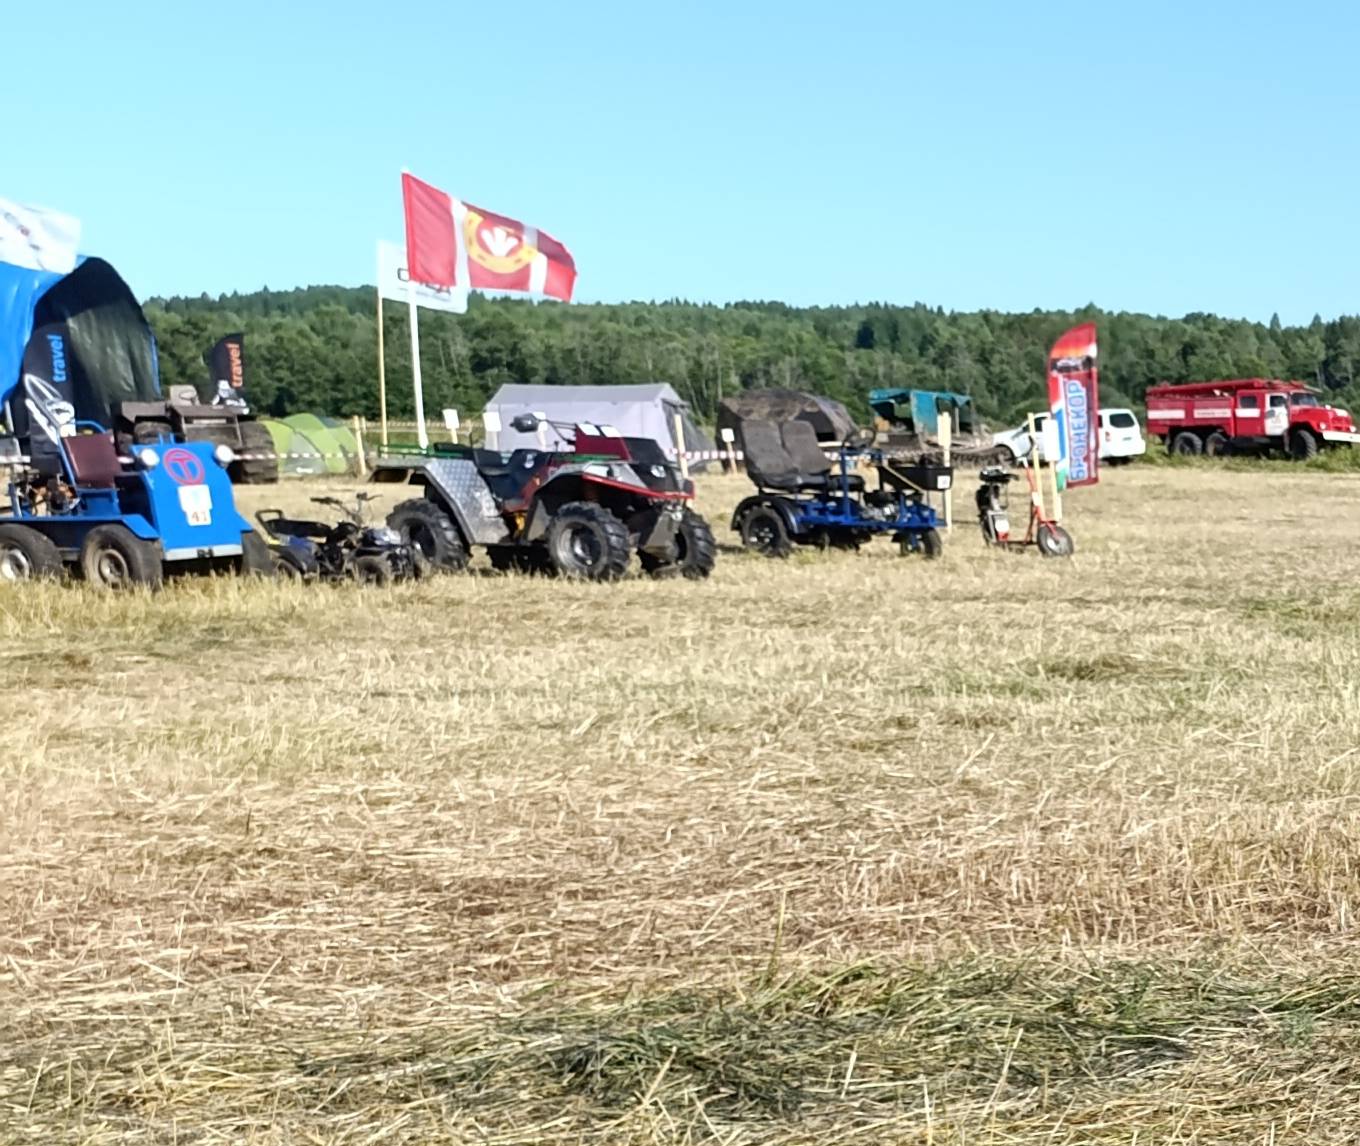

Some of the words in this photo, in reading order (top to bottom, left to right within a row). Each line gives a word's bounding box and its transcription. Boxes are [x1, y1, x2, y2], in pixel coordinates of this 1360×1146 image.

[47, 334, 67, 383] travel
[226, 342, 244, 388] travel
[1067, 381, 1088, 482] БРОНЕКОР
